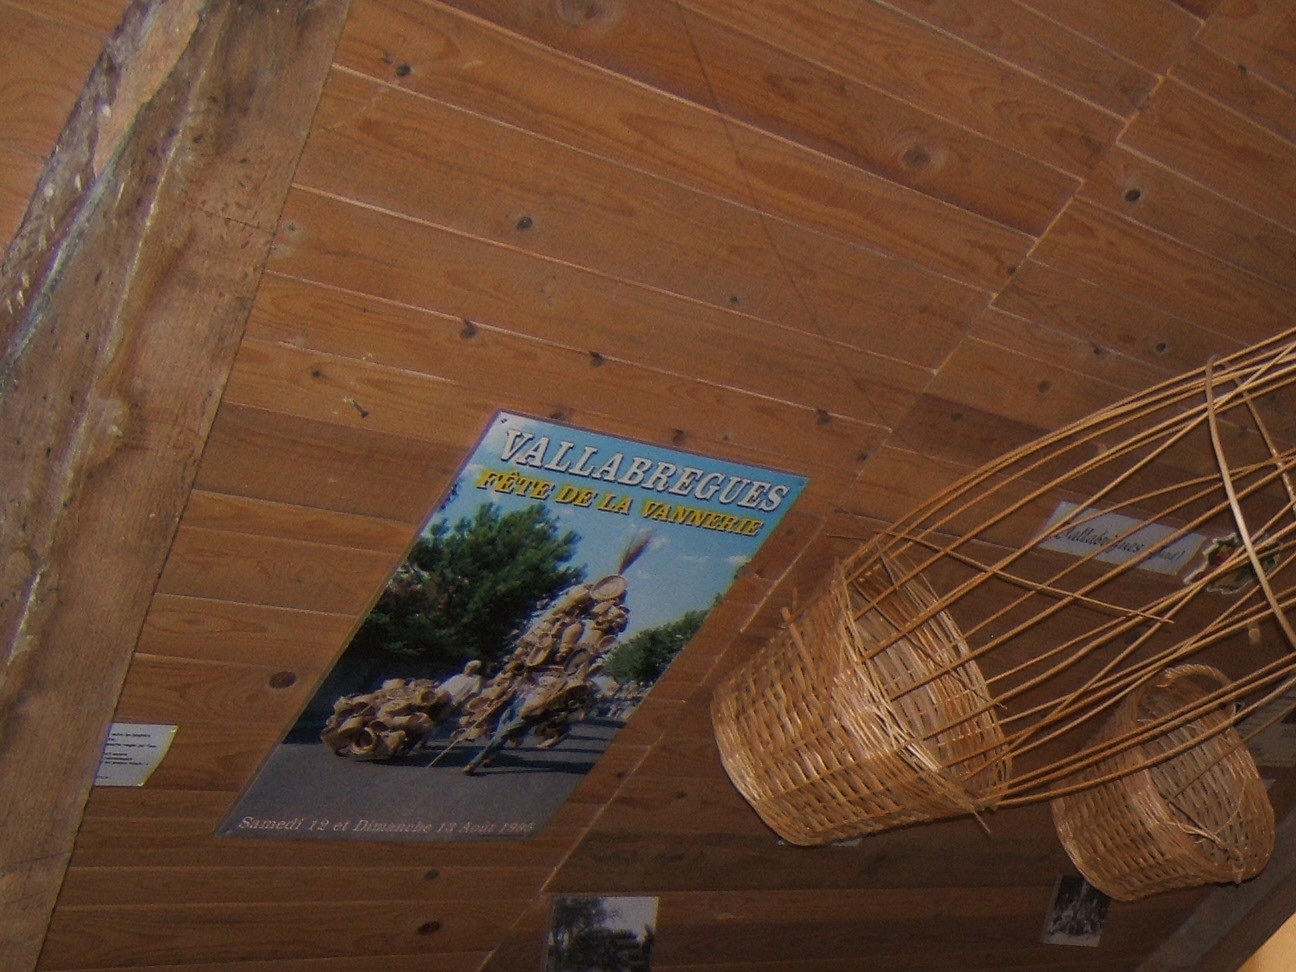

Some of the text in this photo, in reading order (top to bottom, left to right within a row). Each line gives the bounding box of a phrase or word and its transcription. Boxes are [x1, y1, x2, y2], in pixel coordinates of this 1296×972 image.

[476, 471, 764, 537] FÊTE DE LA VANNERIE
[499, 429, 791, 513] VALLABREGUES
[238, 816, 304, 831] Samedi
[308, 818, 330, 832] 12
[333, 820, 349, 832] et
[352, 819, 432, 834] Dimanche
